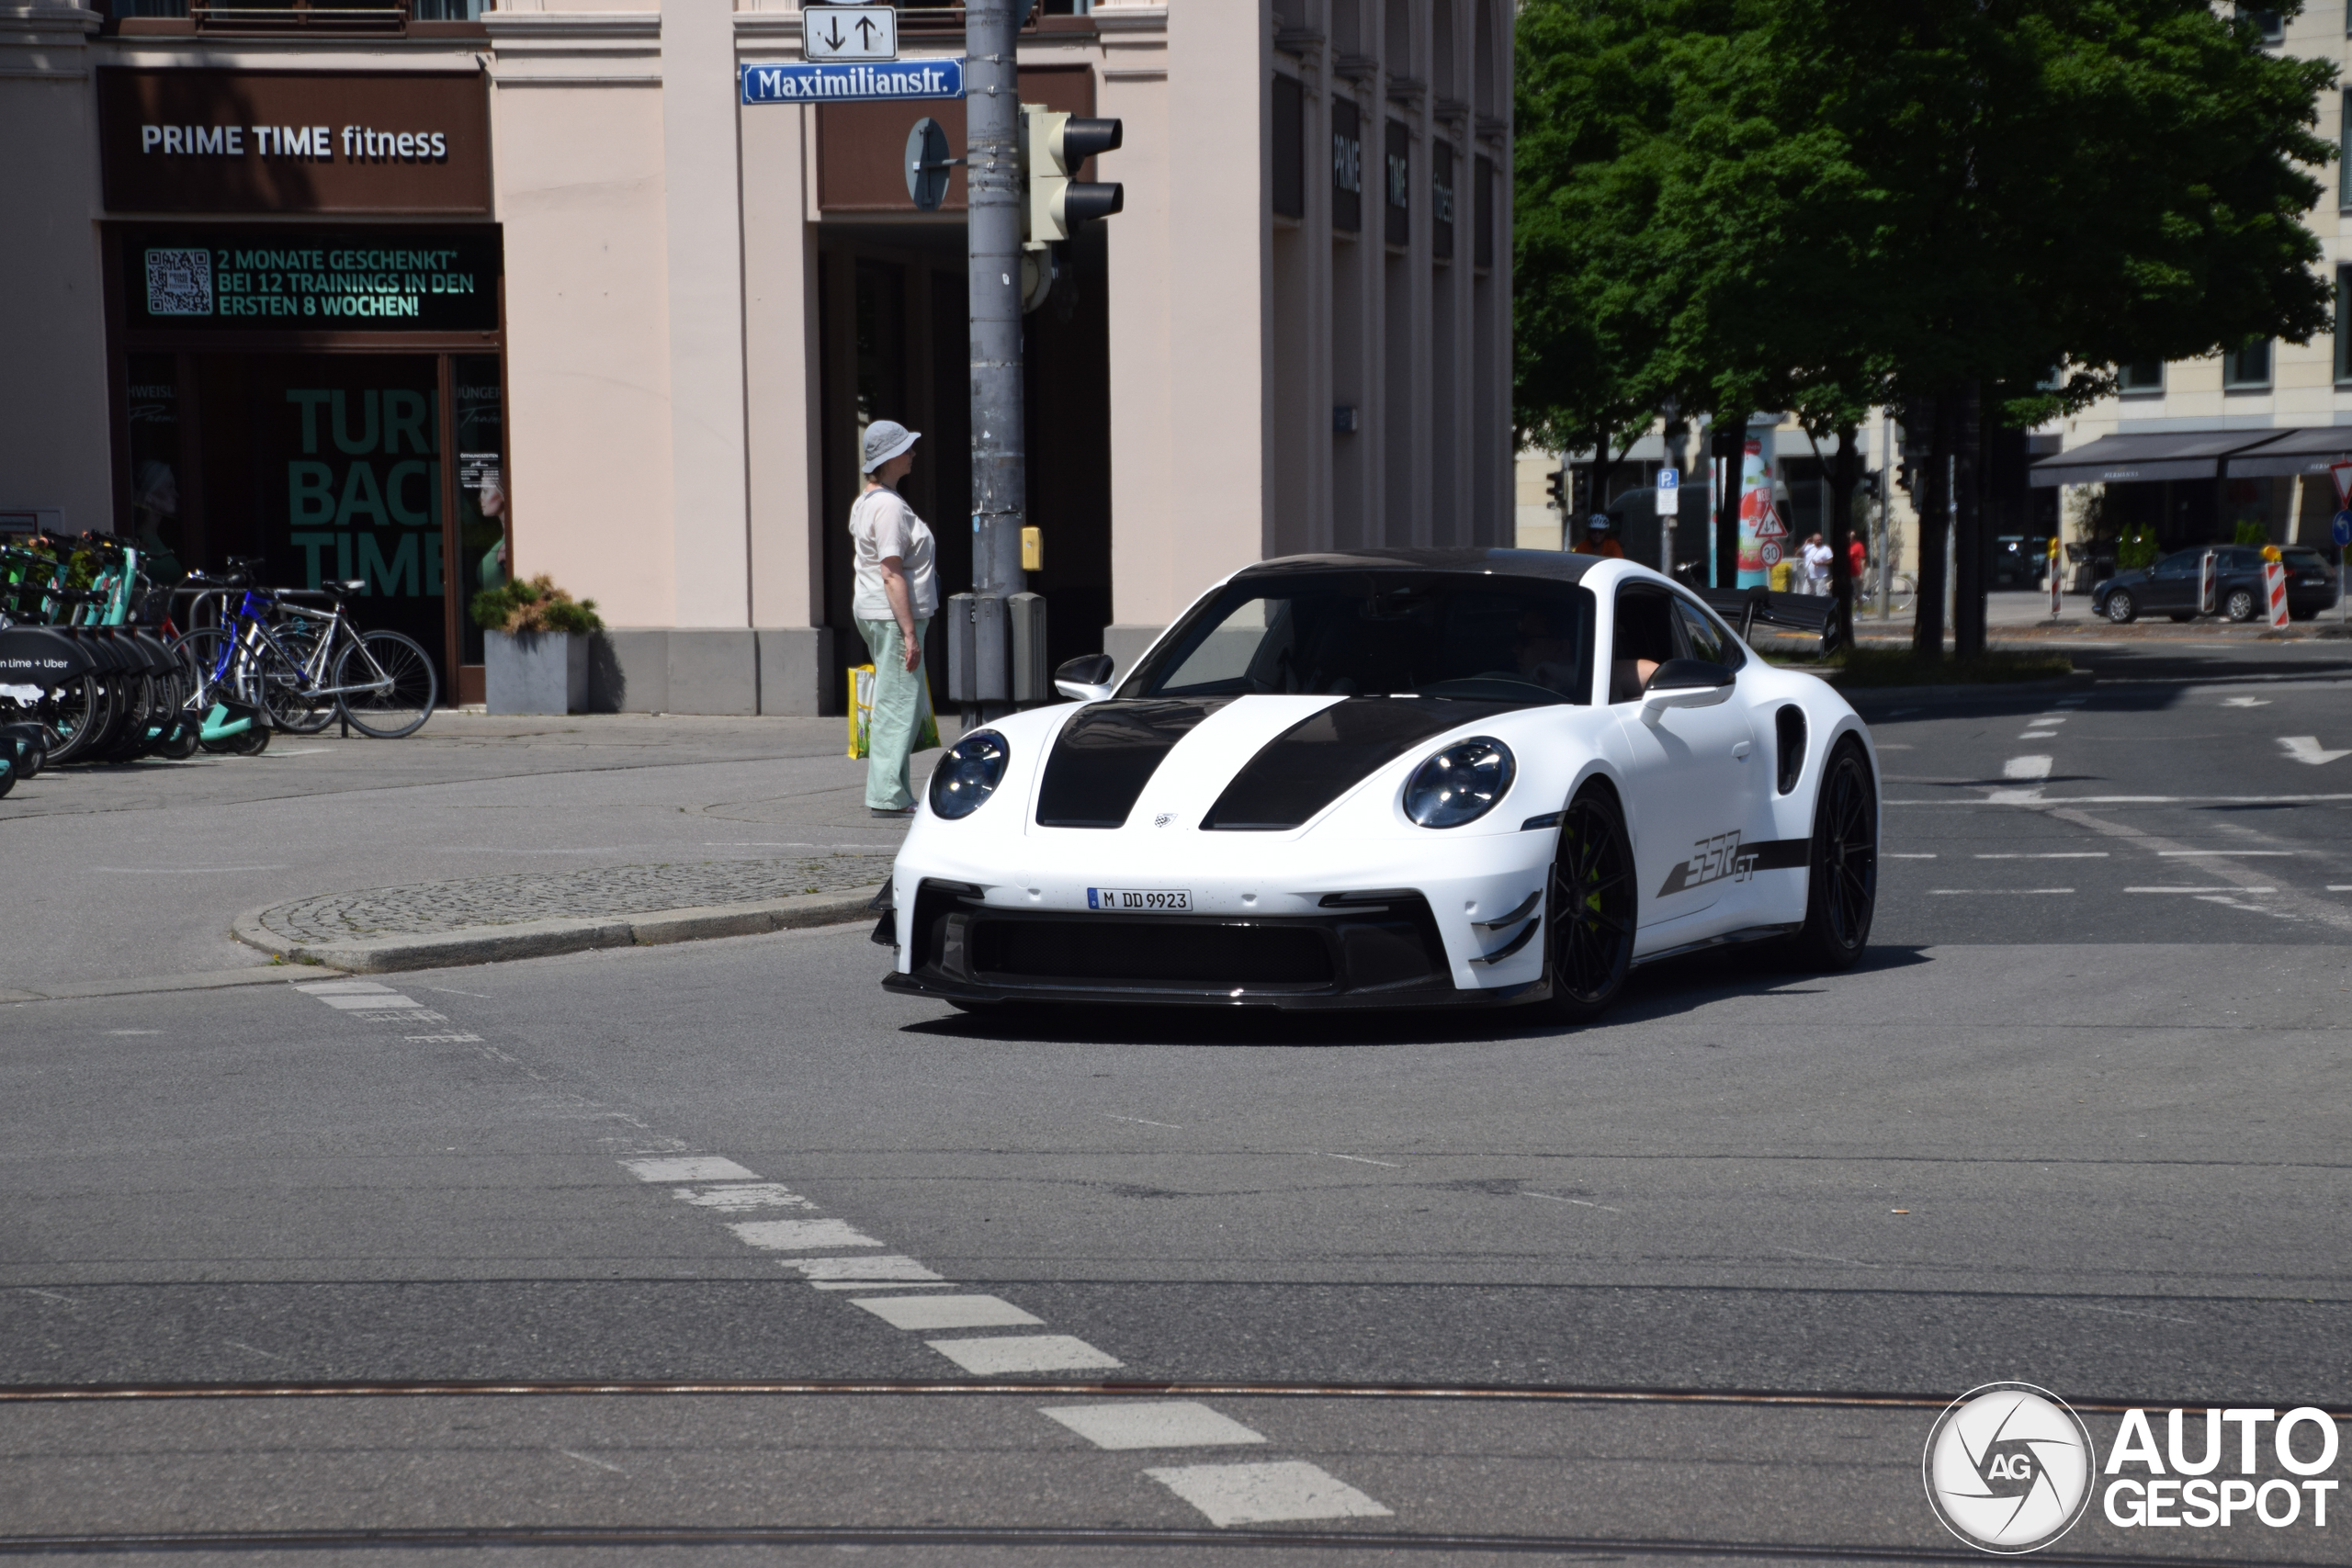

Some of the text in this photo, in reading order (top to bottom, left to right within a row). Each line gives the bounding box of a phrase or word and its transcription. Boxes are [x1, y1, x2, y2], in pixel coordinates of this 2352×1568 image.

[759, 67, 948, 97] Maximilianstr.
[141, 125, 447, 159] PRIME TIME fitness
[1334, 132, 1361, 193] PRIME
[1388, 153, 1406, 209] TIME
[218, 250, 231, 269] 2
[235, 251, 323, 270] MONATE
[218, 273, 474, 294] BEI 12 TRAININGS IN DEN
[219, 296, 420, 317] ERSTEN 8 WOCHEN!
[286, 388, 440, 455] TUR
[1661, 471, 1672, 487] P
[288, 459, 443, 526] BAC
[1763, 547, 1778, 560] 30
[8, 659, 32, 669] Lime
[43, 659, 69, 669] Uber
[1103, 892, 1115, 907] M
[1123, 893, 1144, 908] DD
[1147, 893, 1187, 908] 9923
